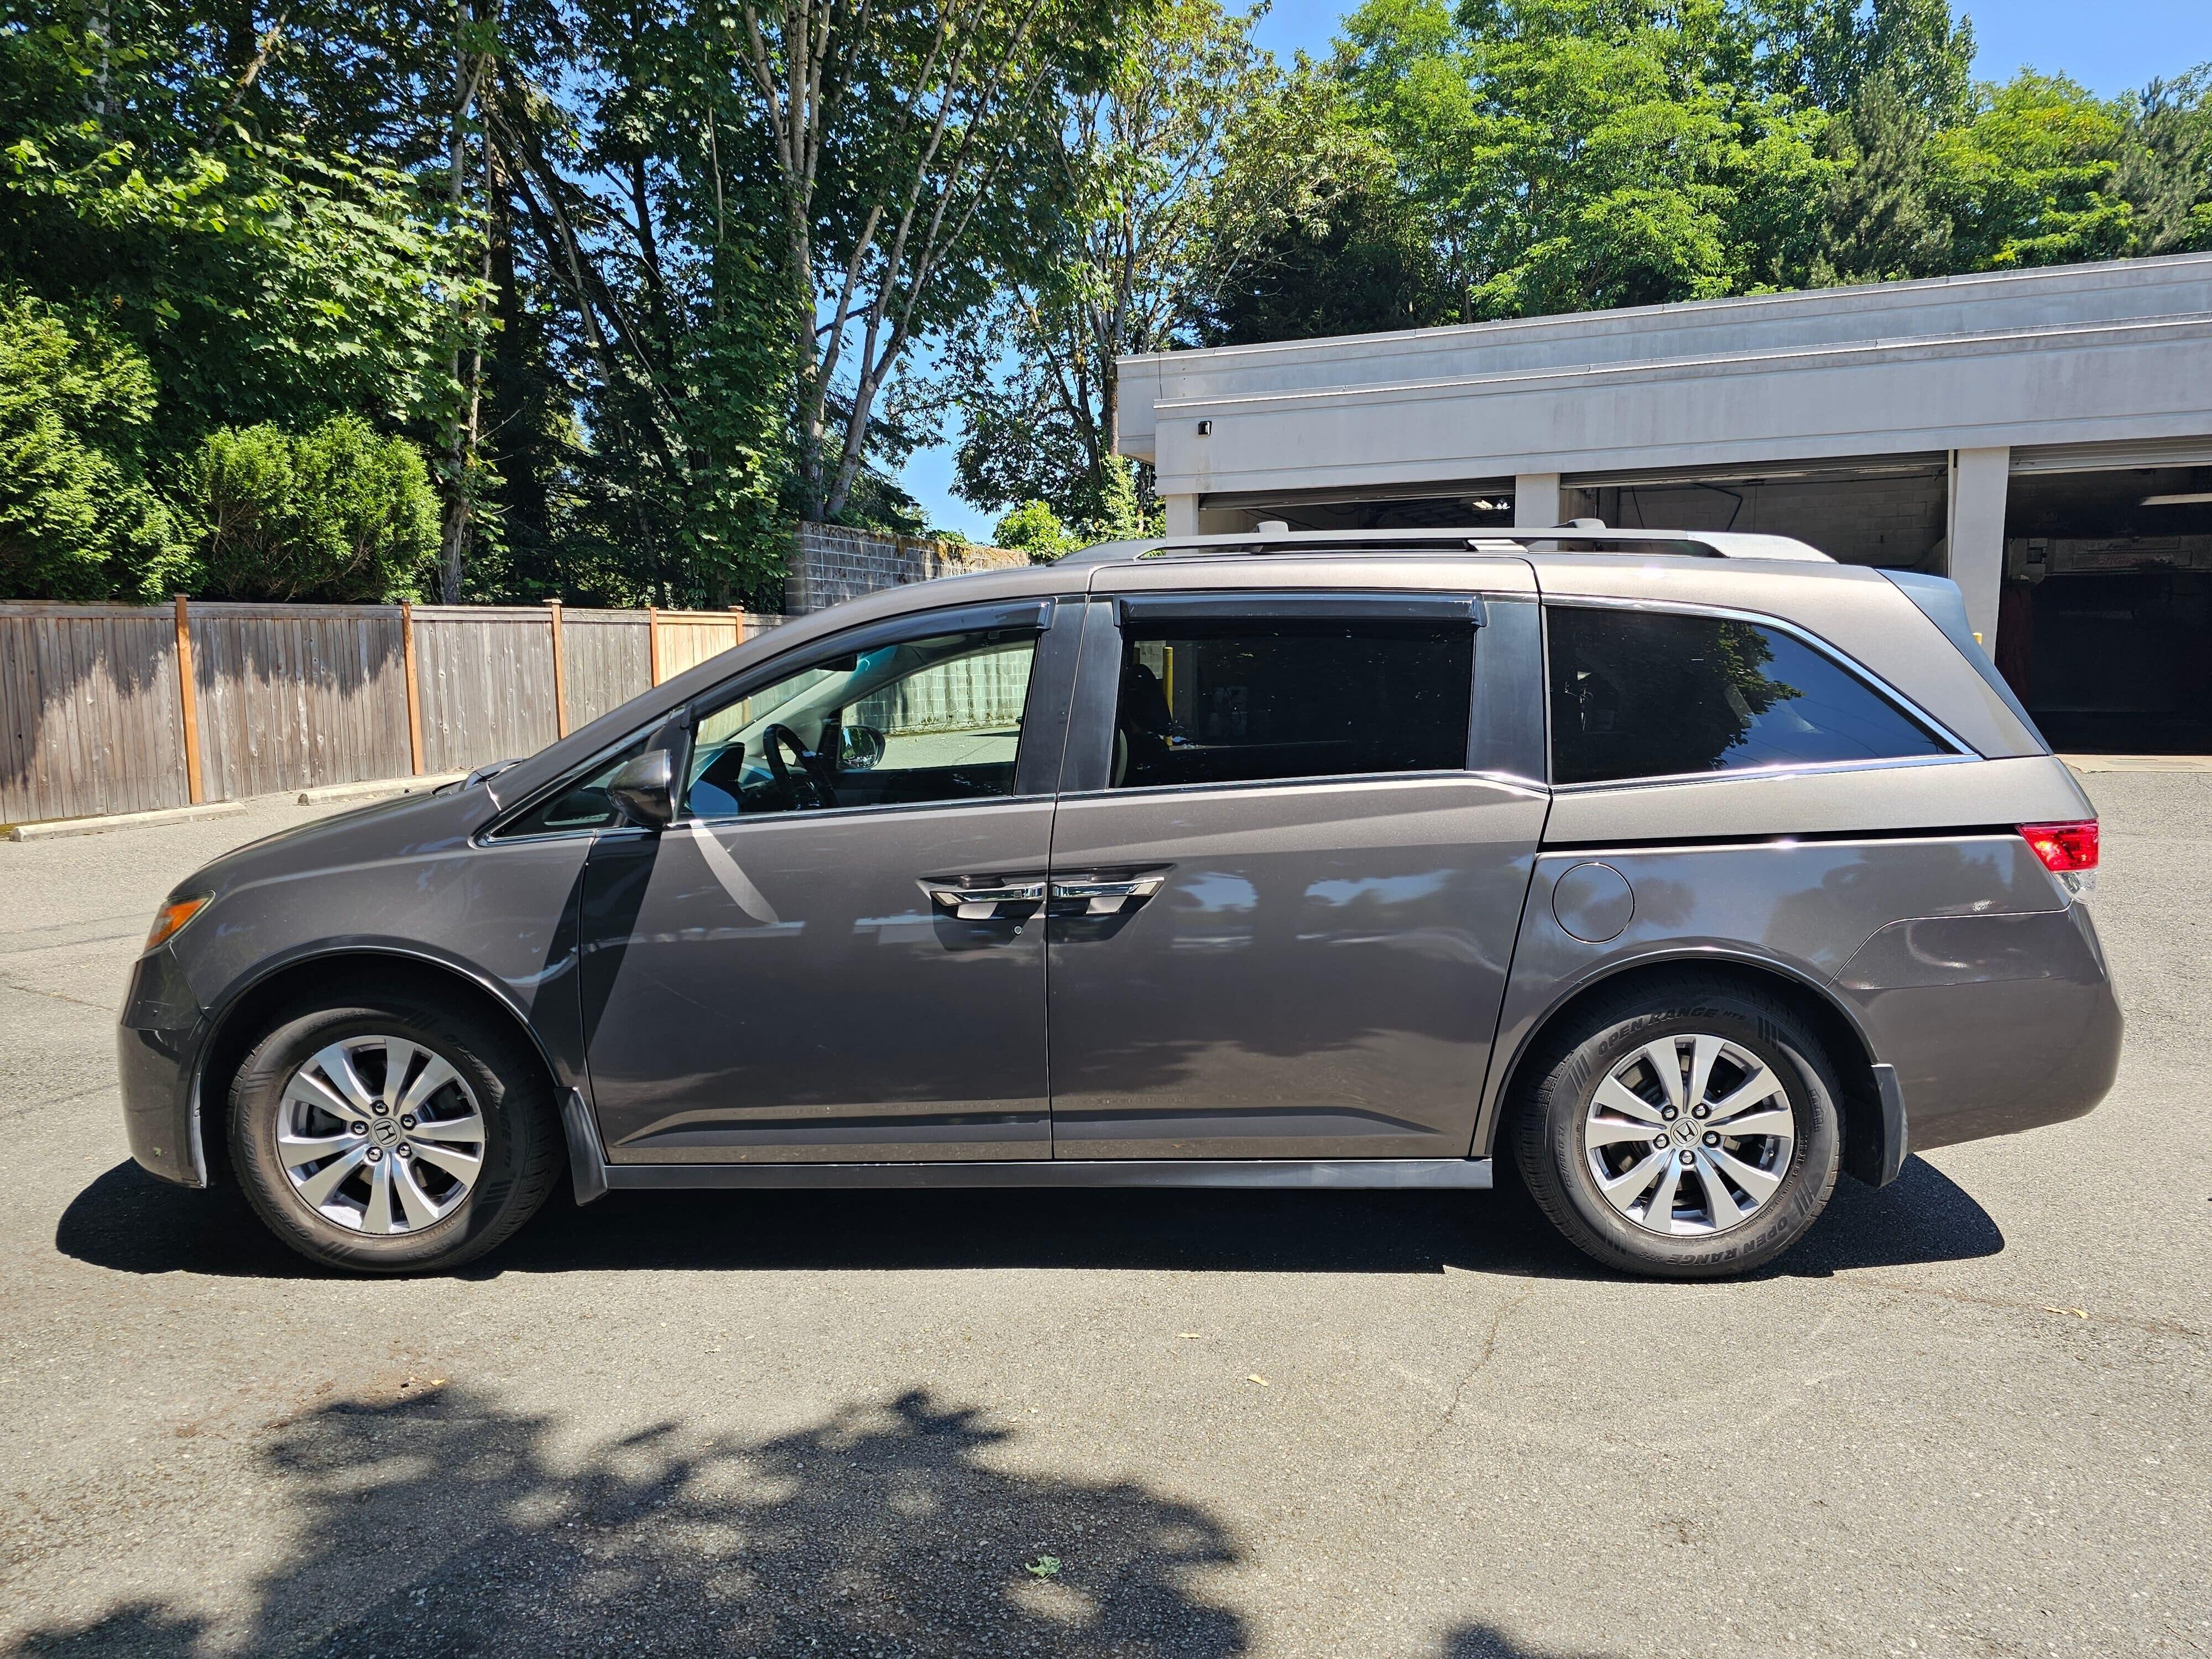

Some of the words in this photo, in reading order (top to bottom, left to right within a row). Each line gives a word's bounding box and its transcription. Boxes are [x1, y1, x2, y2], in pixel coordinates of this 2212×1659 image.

[1598, 1017, 1644, 1057] OPEN
[1648, 1007, 1718, 1026] RANGE
[1743, 1217, 1788, 1255] OPEN
[1667, 1248, 1738, 1266] RANGE
